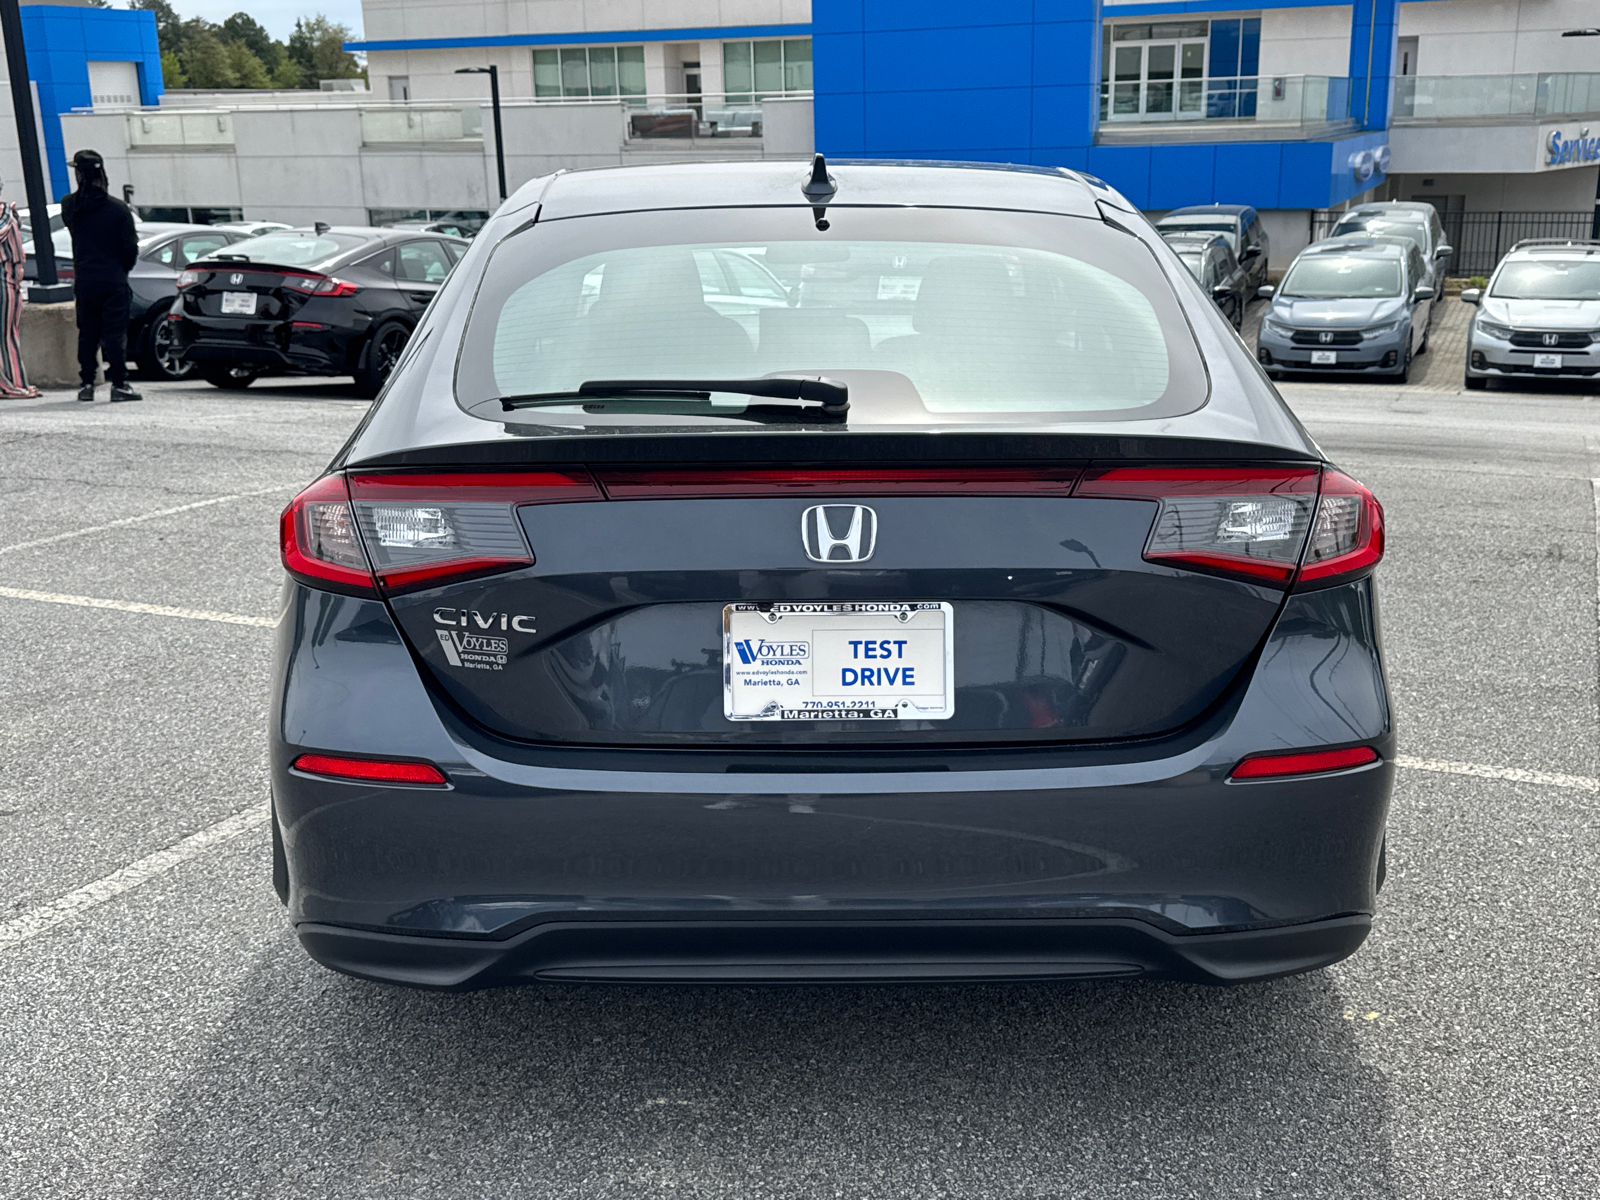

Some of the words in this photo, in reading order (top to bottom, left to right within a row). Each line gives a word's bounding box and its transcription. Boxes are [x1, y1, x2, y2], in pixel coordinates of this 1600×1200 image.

[1546, 128, 1600, 164] Service
[433, 607, 536, 633] CIVIC
[450, 630, 507, 653] VOYLES
[743, 639, 807, 662] VOYLES
[848, 640, 907, 659] TEST
[460, 653, 496, 663] HONDA
[744, 678, 784, 687] Marietta,
[786, 678, 800, 686] GA
[841, 667, 915, 686] DRIVE
[783, 709, 864, 719] Marietta,
[869, 709, 896, 719] GA
[802, 701, 876, 709] 770-951-2211
